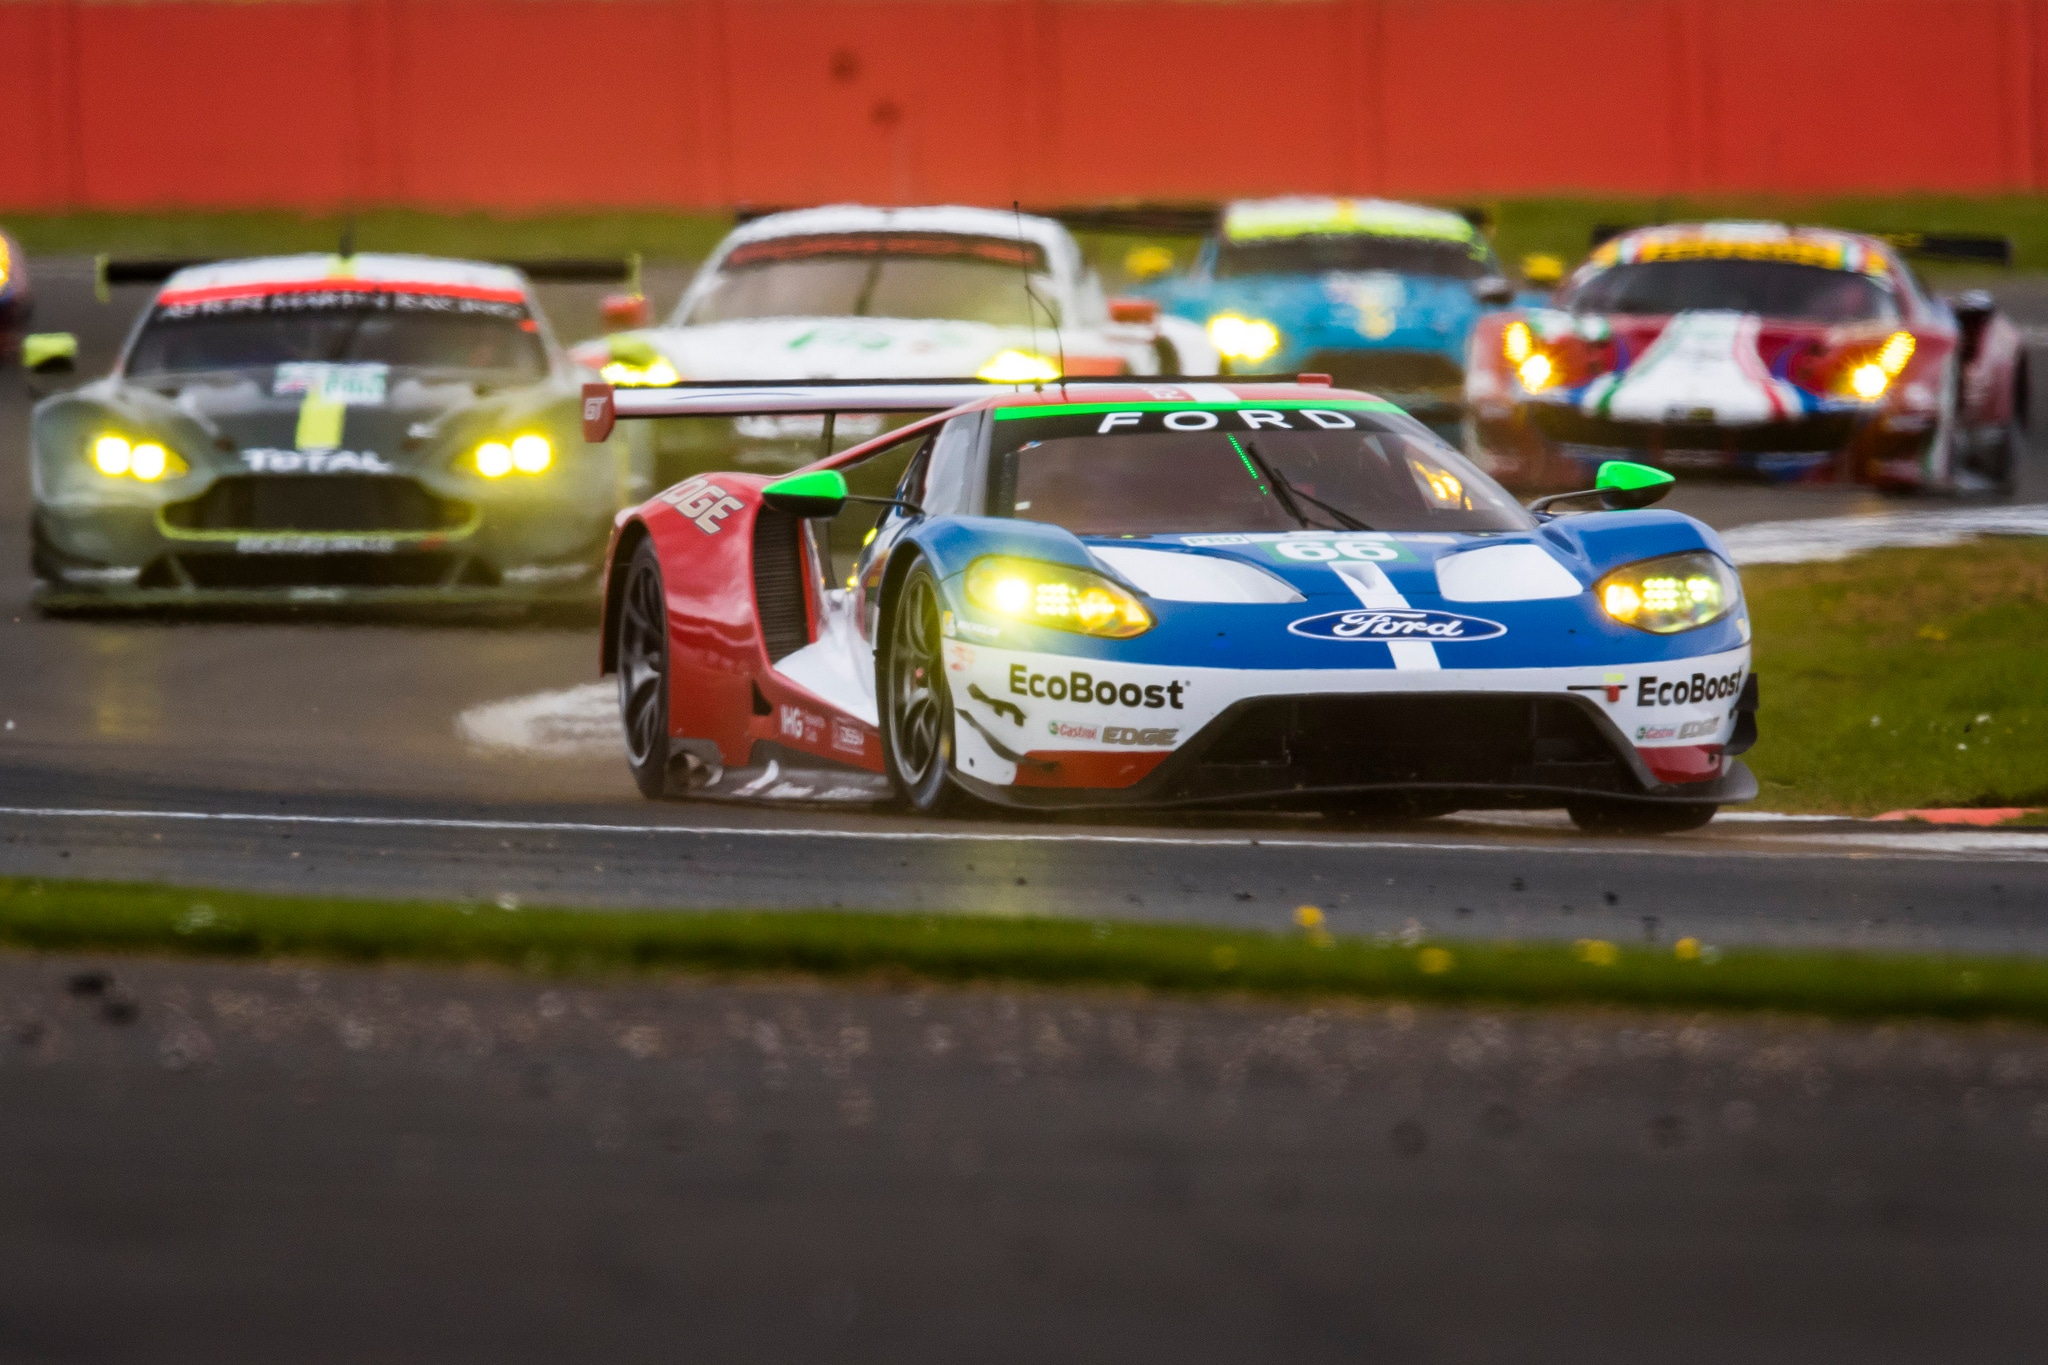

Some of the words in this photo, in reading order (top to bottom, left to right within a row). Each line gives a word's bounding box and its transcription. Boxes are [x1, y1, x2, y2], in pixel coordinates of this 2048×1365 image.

[1097, 409, 1356, 434] FORD
[241, 448, 394, 473] TOTAL
[660, 477, 746, 536] DGE
[1276, 541, 1399, 561] 66
[1332, 612, 1465, 638] Ford
[1009, 662, 1184, 710] EcoBoost
[1637, 668, 1743, 707] EcoBoost
[1102, 725, 1179, 746] EDGE
